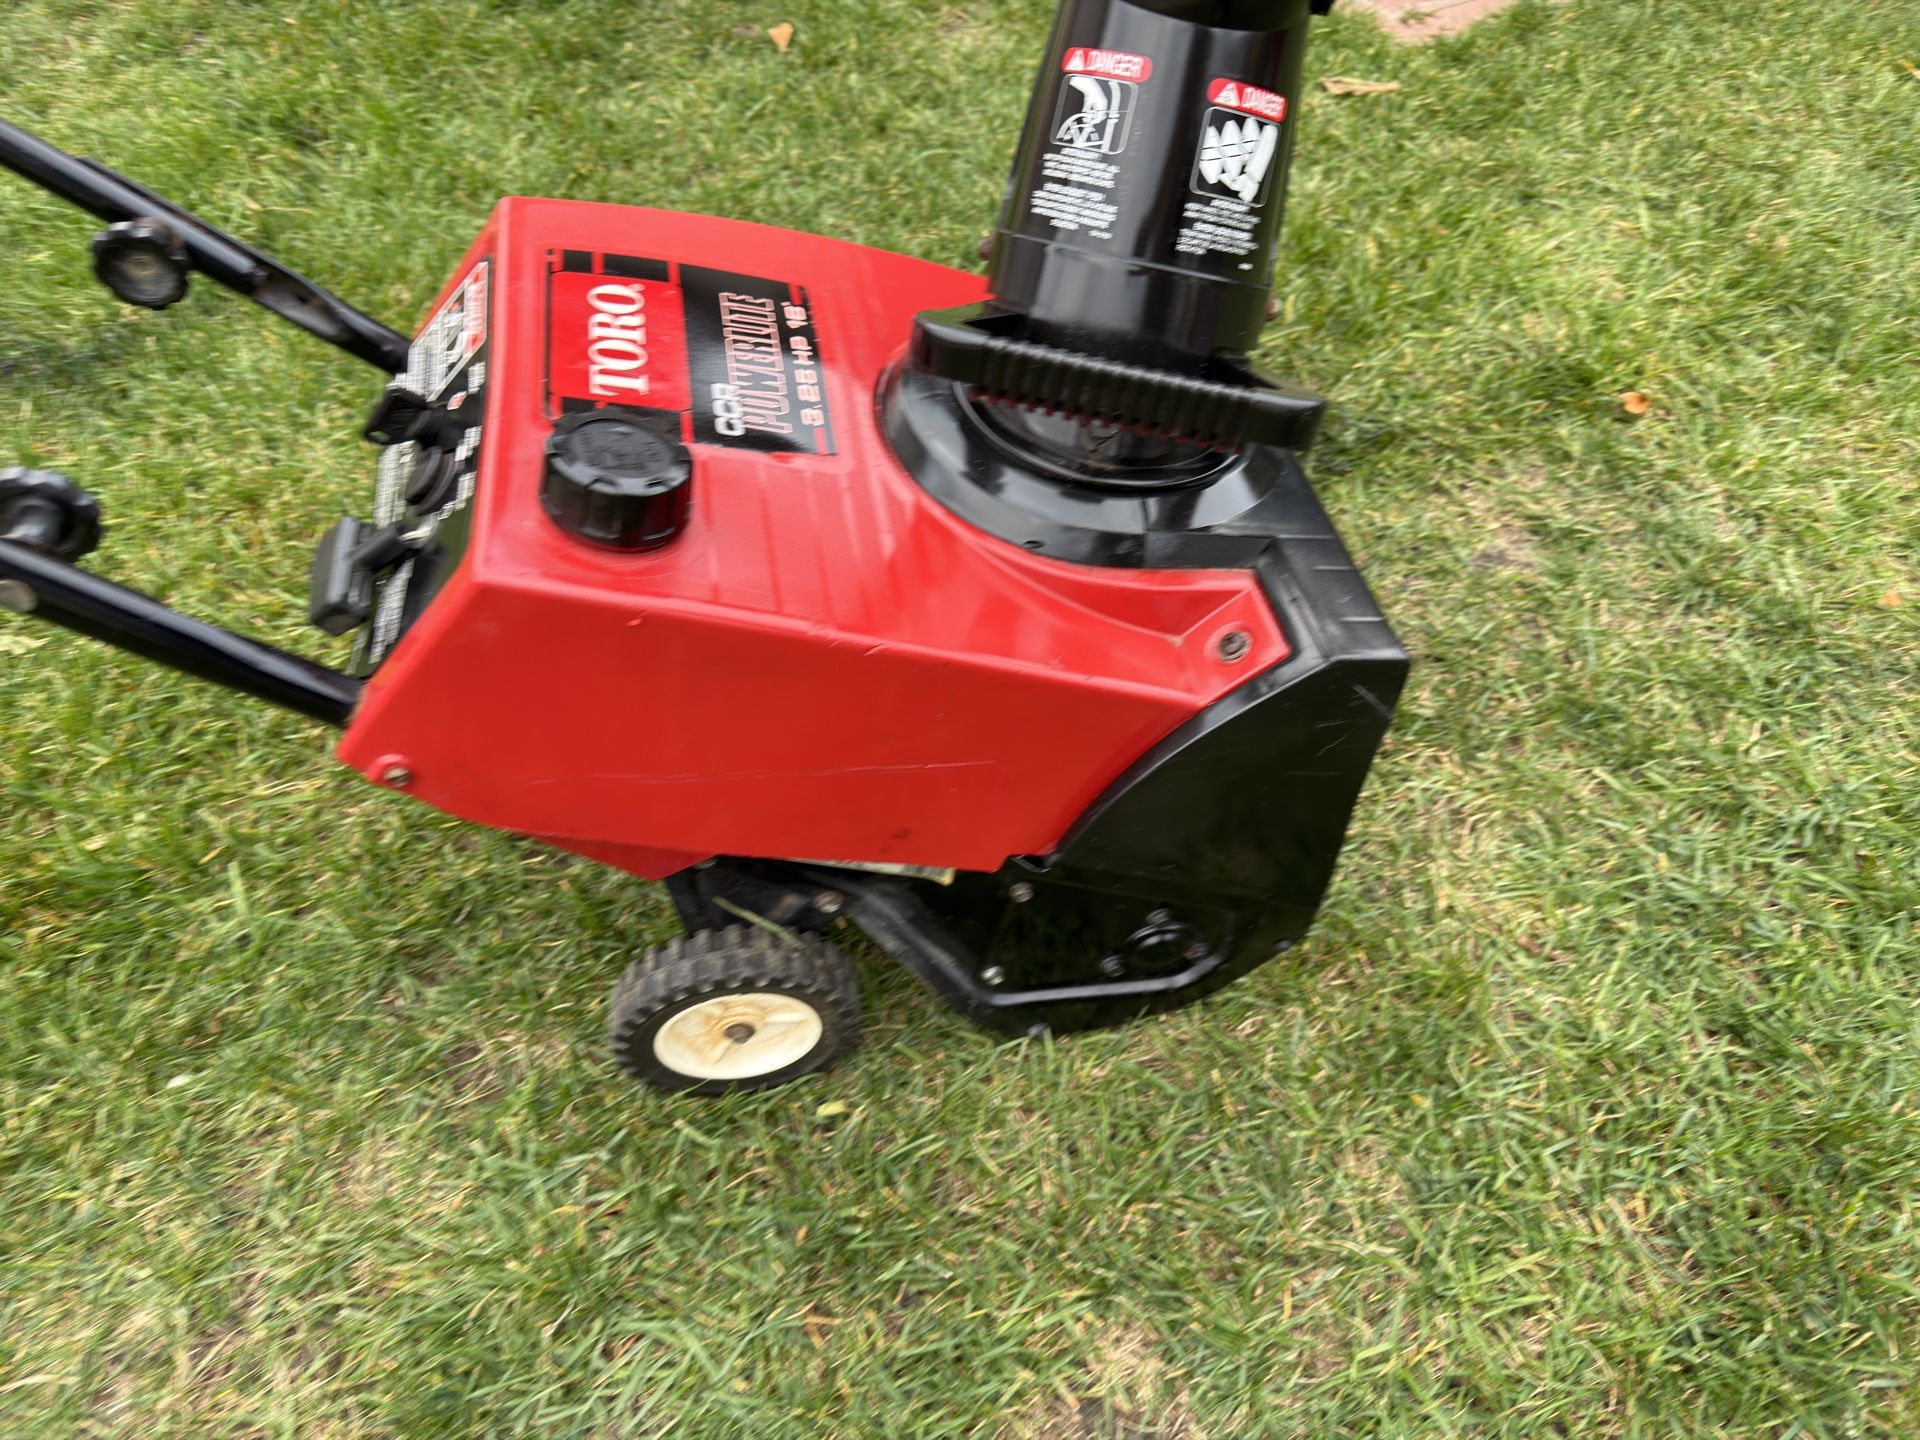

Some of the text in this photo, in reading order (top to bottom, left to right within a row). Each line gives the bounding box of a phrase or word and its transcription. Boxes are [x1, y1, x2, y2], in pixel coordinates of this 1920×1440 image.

[1086, 49, 1145, 79] DANGER
[587, 284, 649, 396] TORO
[789, 335, 816, 366] HP
[711, 383, 746, 437] CCR
